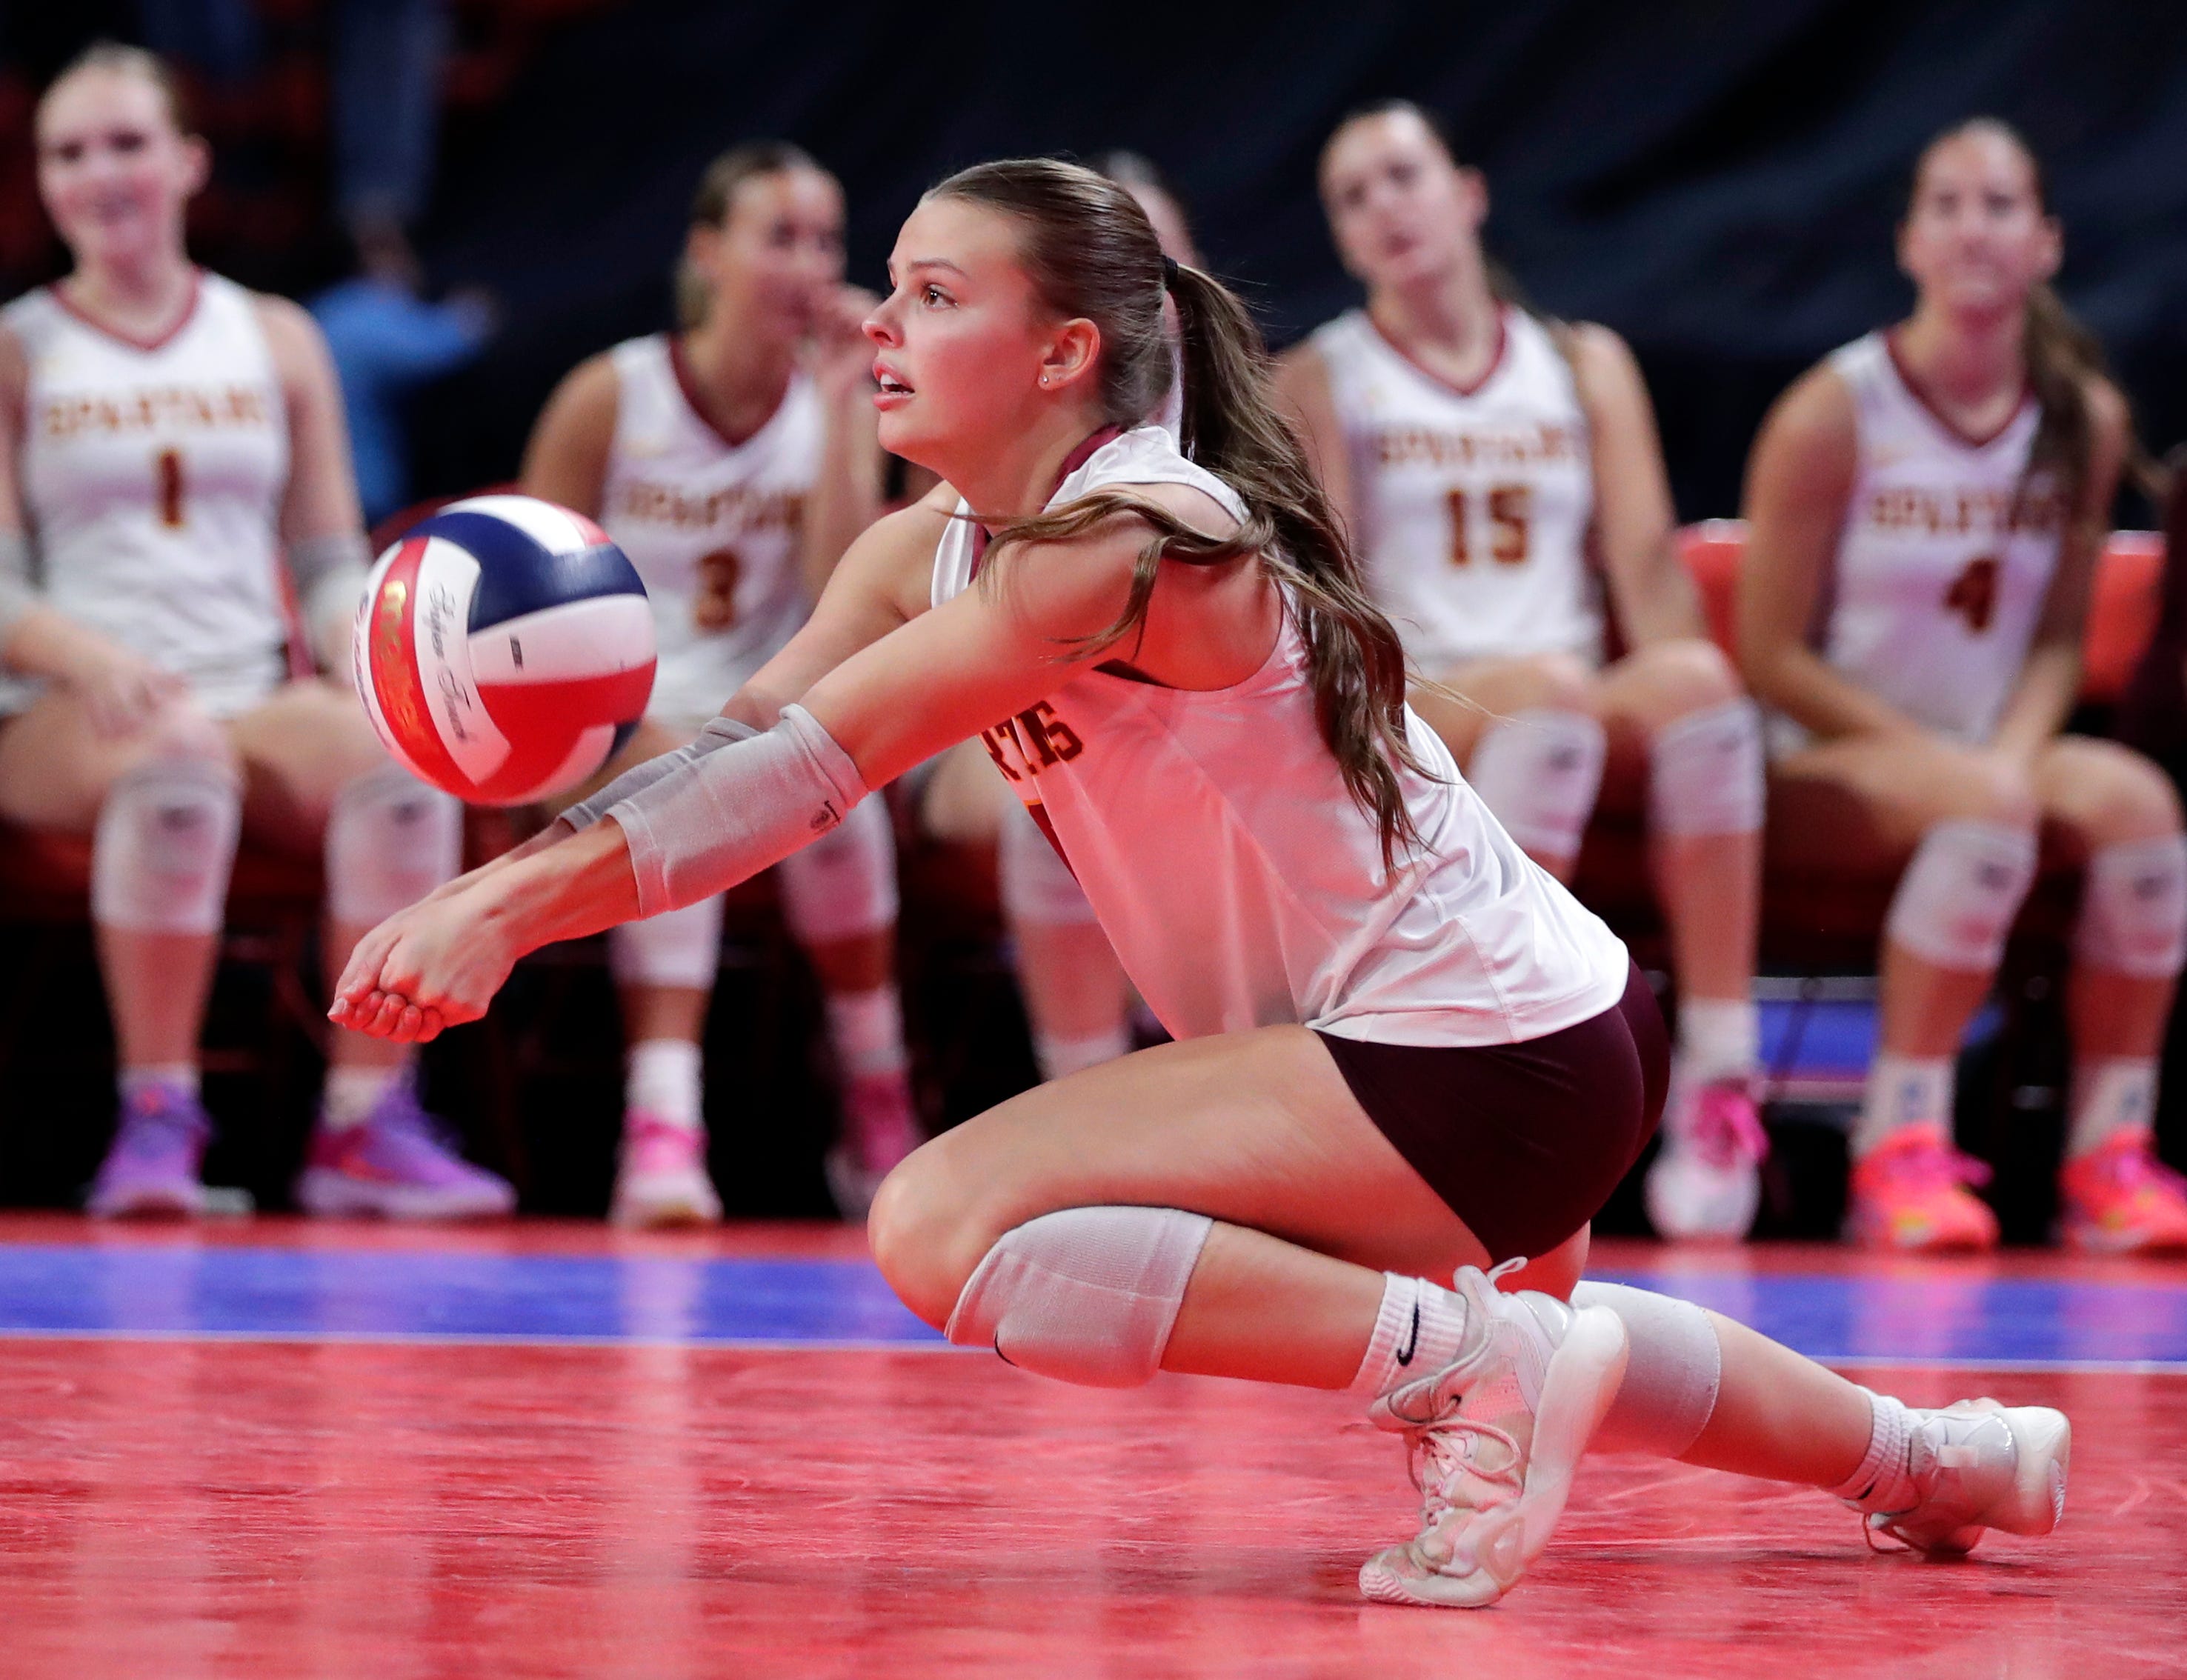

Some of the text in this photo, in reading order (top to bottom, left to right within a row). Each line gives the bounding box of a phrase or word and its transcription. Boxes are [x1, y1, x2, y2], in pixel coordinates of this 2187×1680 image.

[158, 447, 185, 529] 1
[1444, 484, 1529, 567] 15
[693, 550, 740, 636] 3
[1945, 556, 1999, 634] 4
